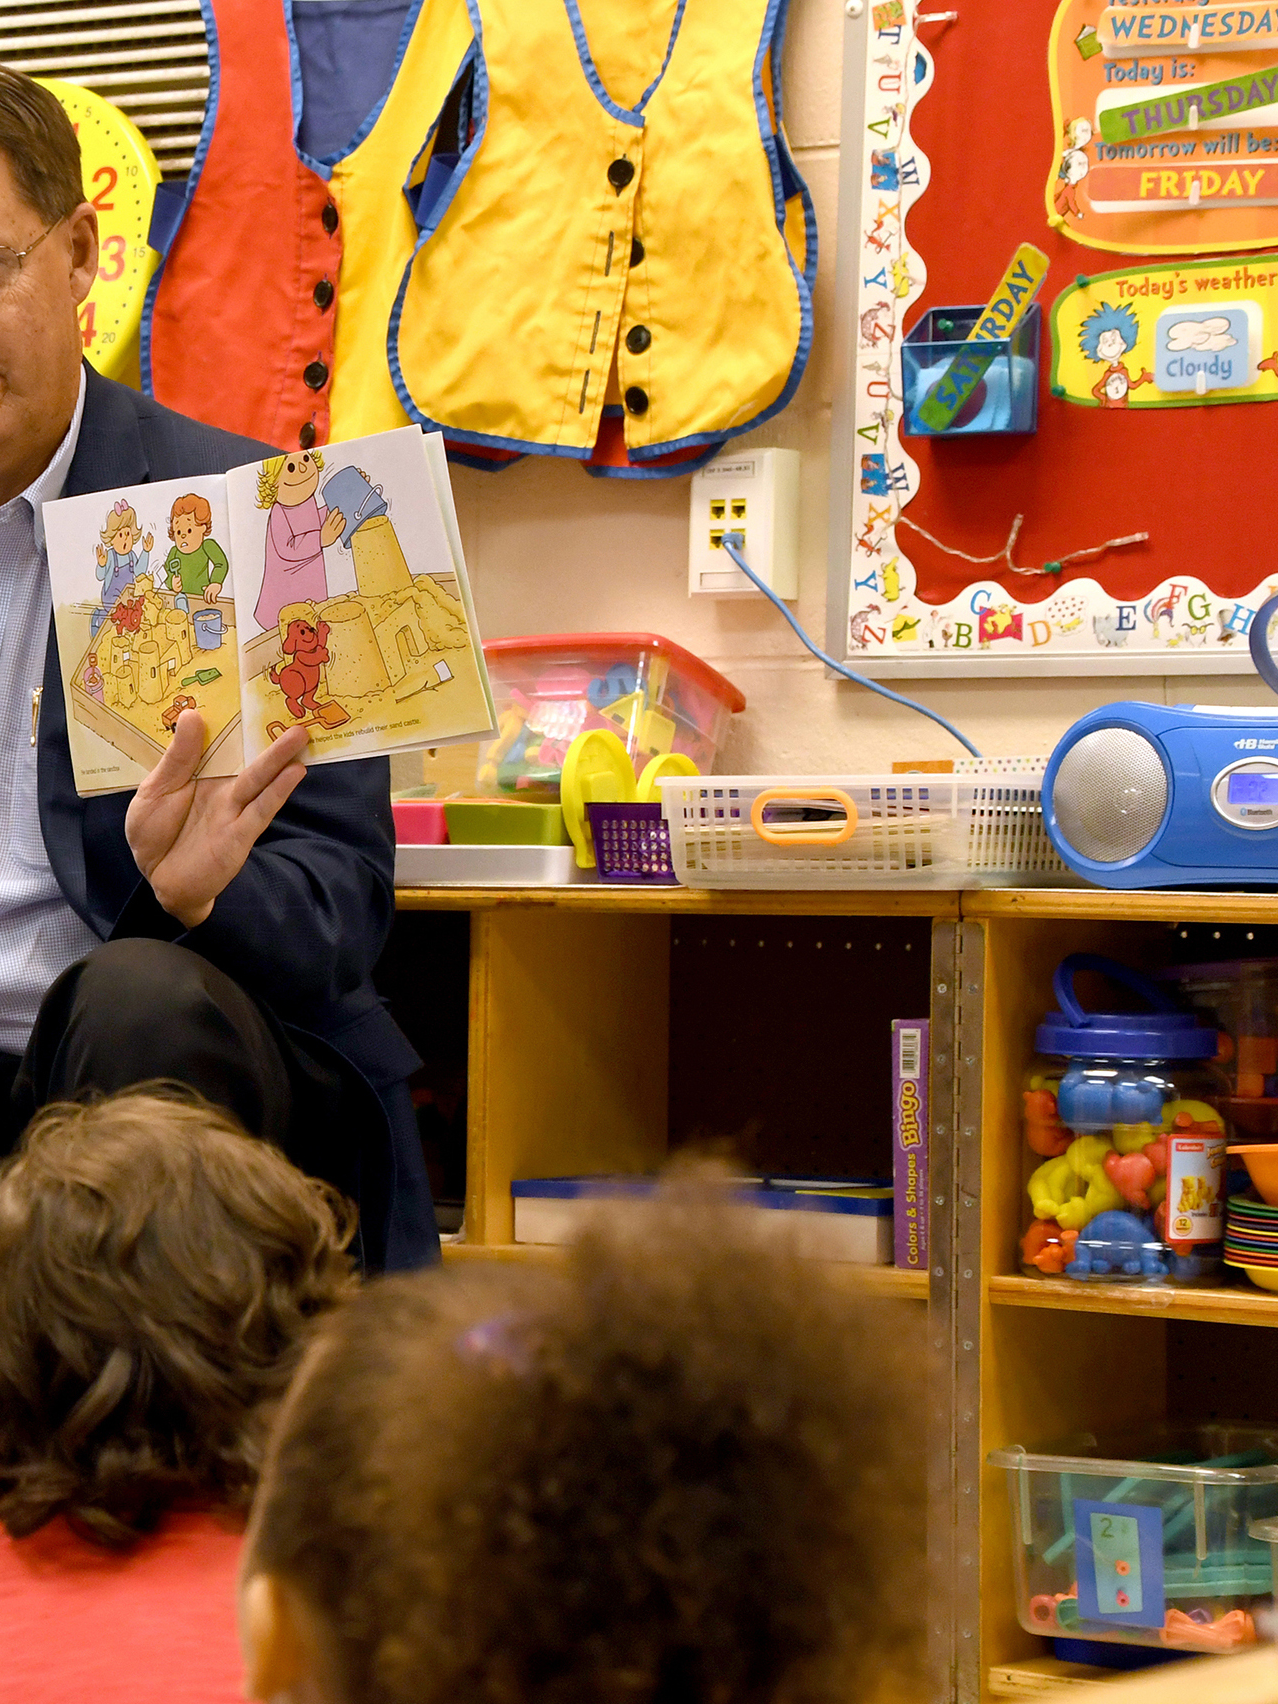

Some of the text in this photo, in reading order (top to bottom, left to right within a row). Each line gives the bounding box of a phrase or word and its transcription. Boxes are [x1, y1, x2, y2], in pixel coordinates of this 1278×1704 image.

[878, 24, 902, 45] T
[1111, 9, 1278, 40] WEDNESDA
[878, 71, 902, 95] U
[1103, 58, 1196, 85] Today is:
[85, 107, 92, 118] 5
[1122, 73, 1278, 135] THURSDAY
[1094, 131, 1278, 162] Tomorrow will be:
[91, 165, 139, 211] 2 10
[1139, 168, 1265, 198] FRIDAY
[877, 197, 899, 223] X
[98, 235, 146, 282] 3 15
[864, 267, 888, 289] Y
[1116, 266, 1278, 300] Today's weather
[102, 332, 116, 343] 20
[1166, 354, 1233, 380] Cloudy
[868, 502, 892, 525] X
[854, 570, 878, 592] Y
[952, 583, 1257, 648] B C D E F G H
[343, 730, 355, 738] kids
[389, 721, 403, 729] sand
[899, 1080, 919, 1147] Bingo
[906, 1153, 919, 1265] Colors & Shapes
[1100, 1517, 1115, 1539] 2
